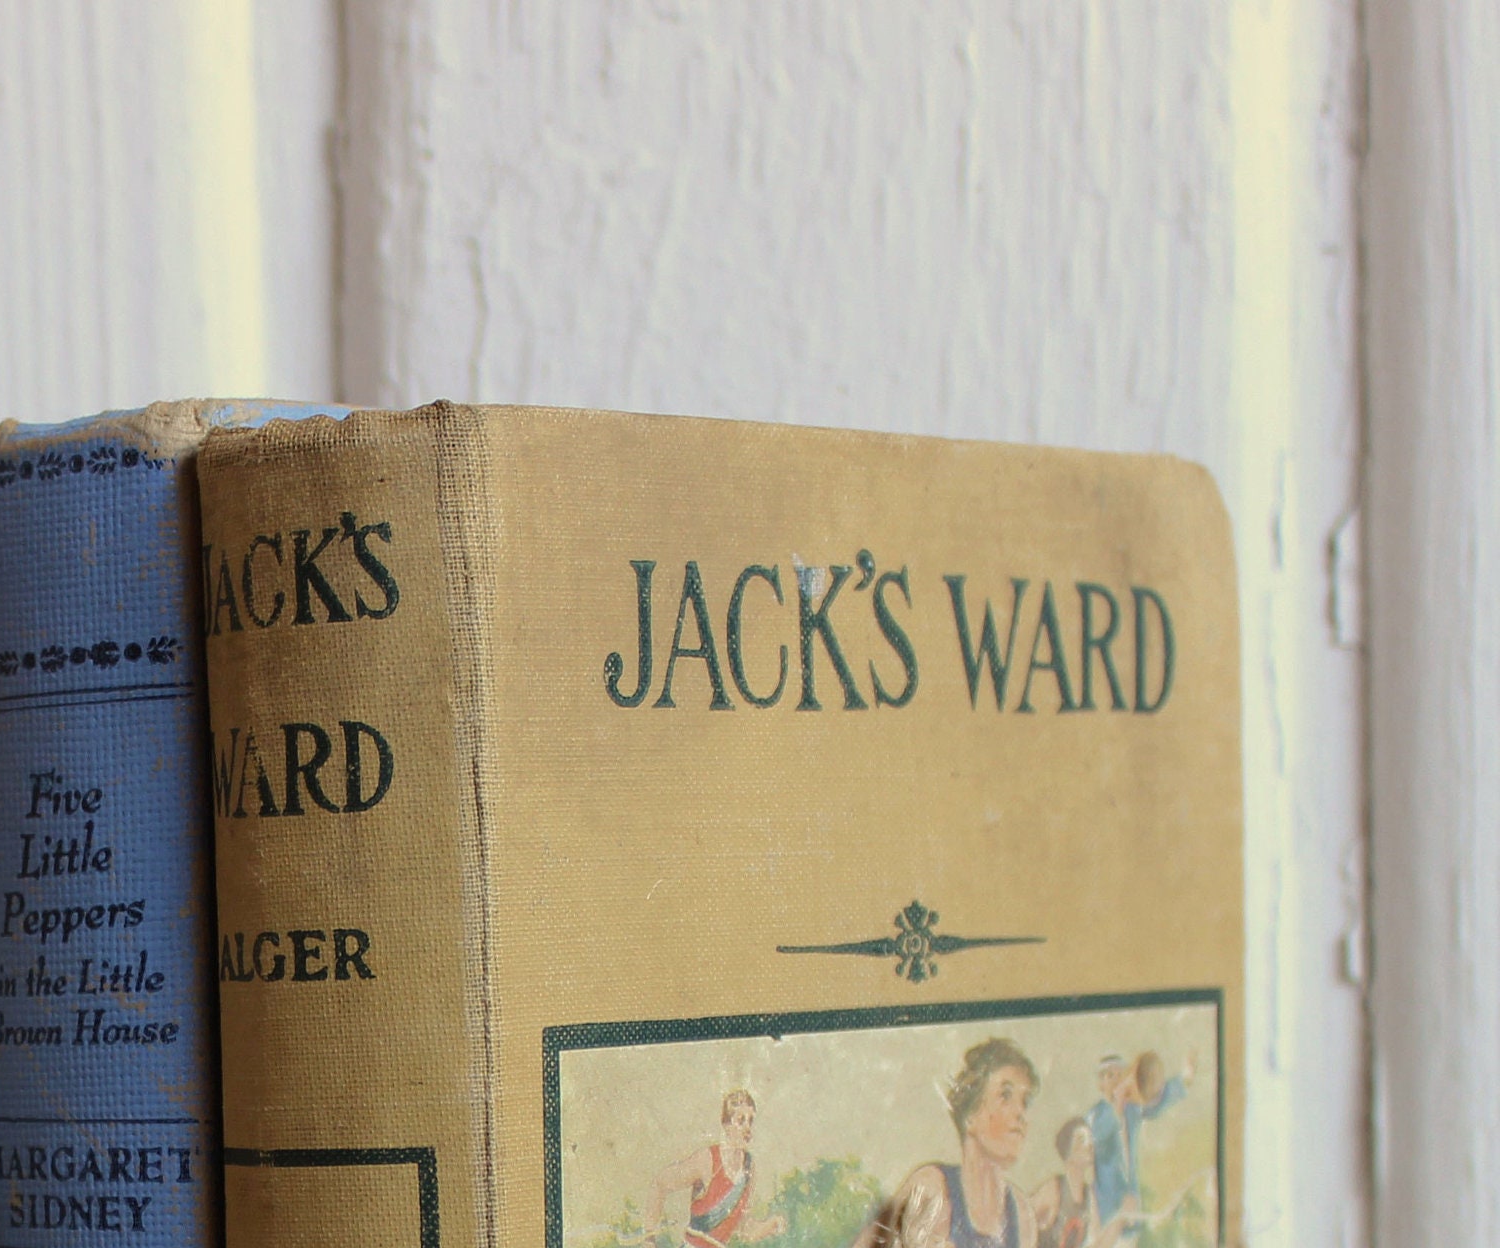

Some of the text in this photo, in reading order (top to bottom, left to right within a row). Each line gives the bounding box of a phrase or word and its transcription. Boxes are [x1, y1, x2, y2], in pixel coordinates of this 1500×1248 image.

[201, 511, 400, 637] JACK'S
[603, 549, 1176, 714] JACK'S WARD
[26, 768, 103, 819] Five
[210, 720, 395, 818] WARD
[17, 820, 114, 879] Little
[1, 891, 147, 945] Peppers
[26, 955, 67, 997] the
[77, 950, 165, 997] Little
[220, 928, 377, 983] ALGER
[72, 1009, 180, 1047] House
[10, 1194, 152, 1232] SIDNEY
